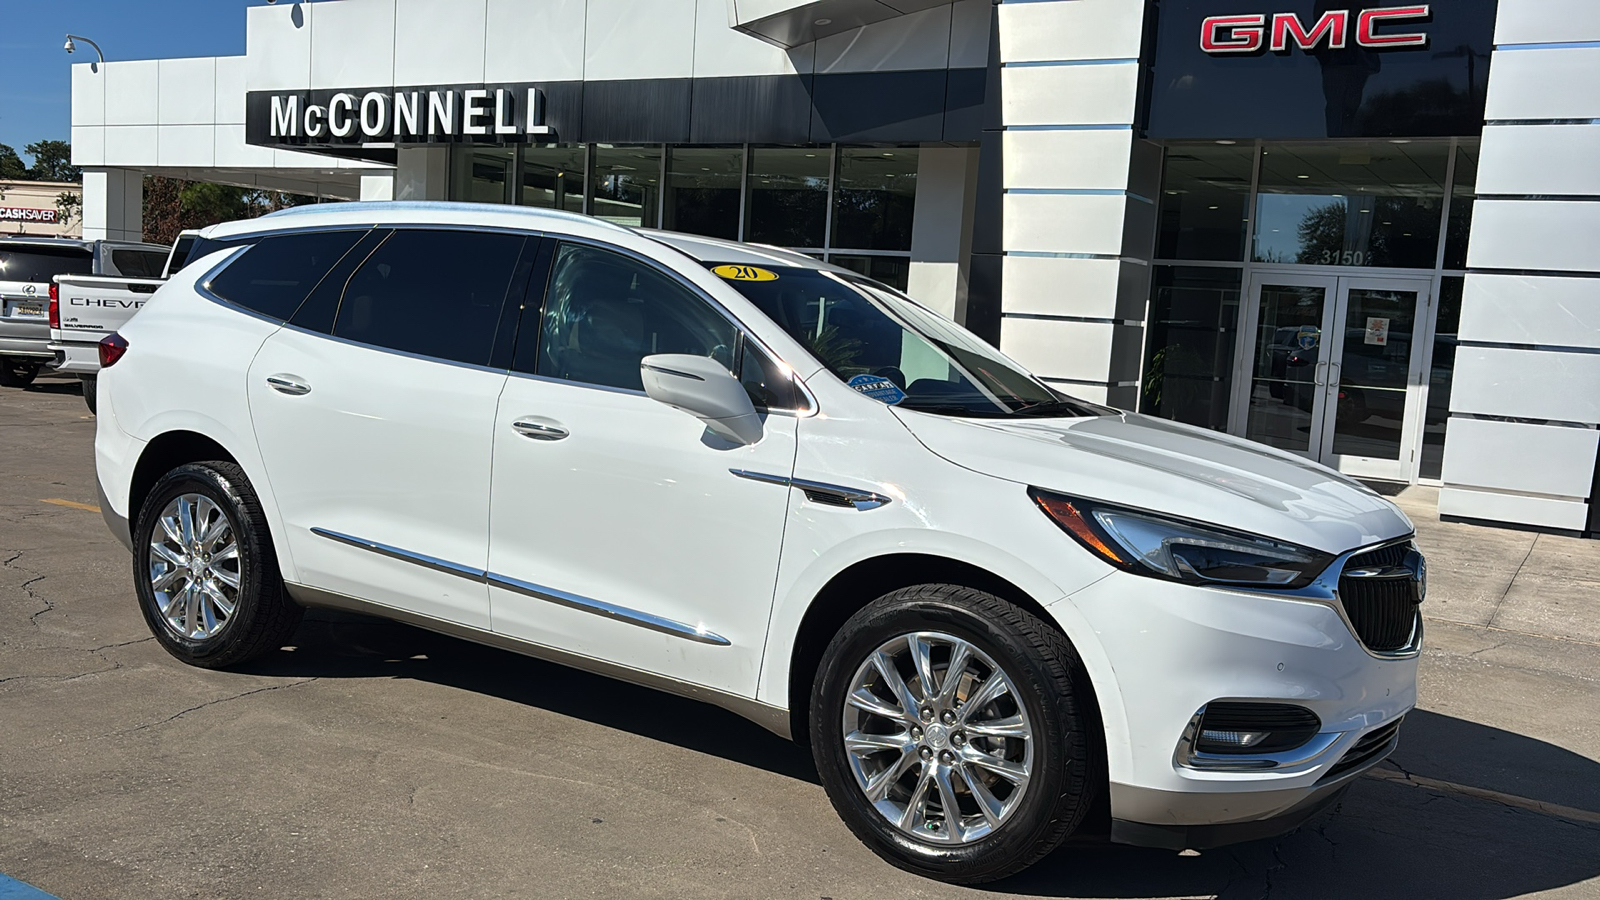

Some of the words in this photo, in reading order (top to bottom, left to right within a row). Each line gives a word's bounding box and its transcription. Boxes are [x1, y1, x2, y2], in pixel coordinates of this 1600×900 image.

[1200, 4, 1430, 53] GMC
[269, 87, 549, 137] McCONNELL
[729, 266, 758, 279] 20
[1320, 249, 1364, 266] 3150
